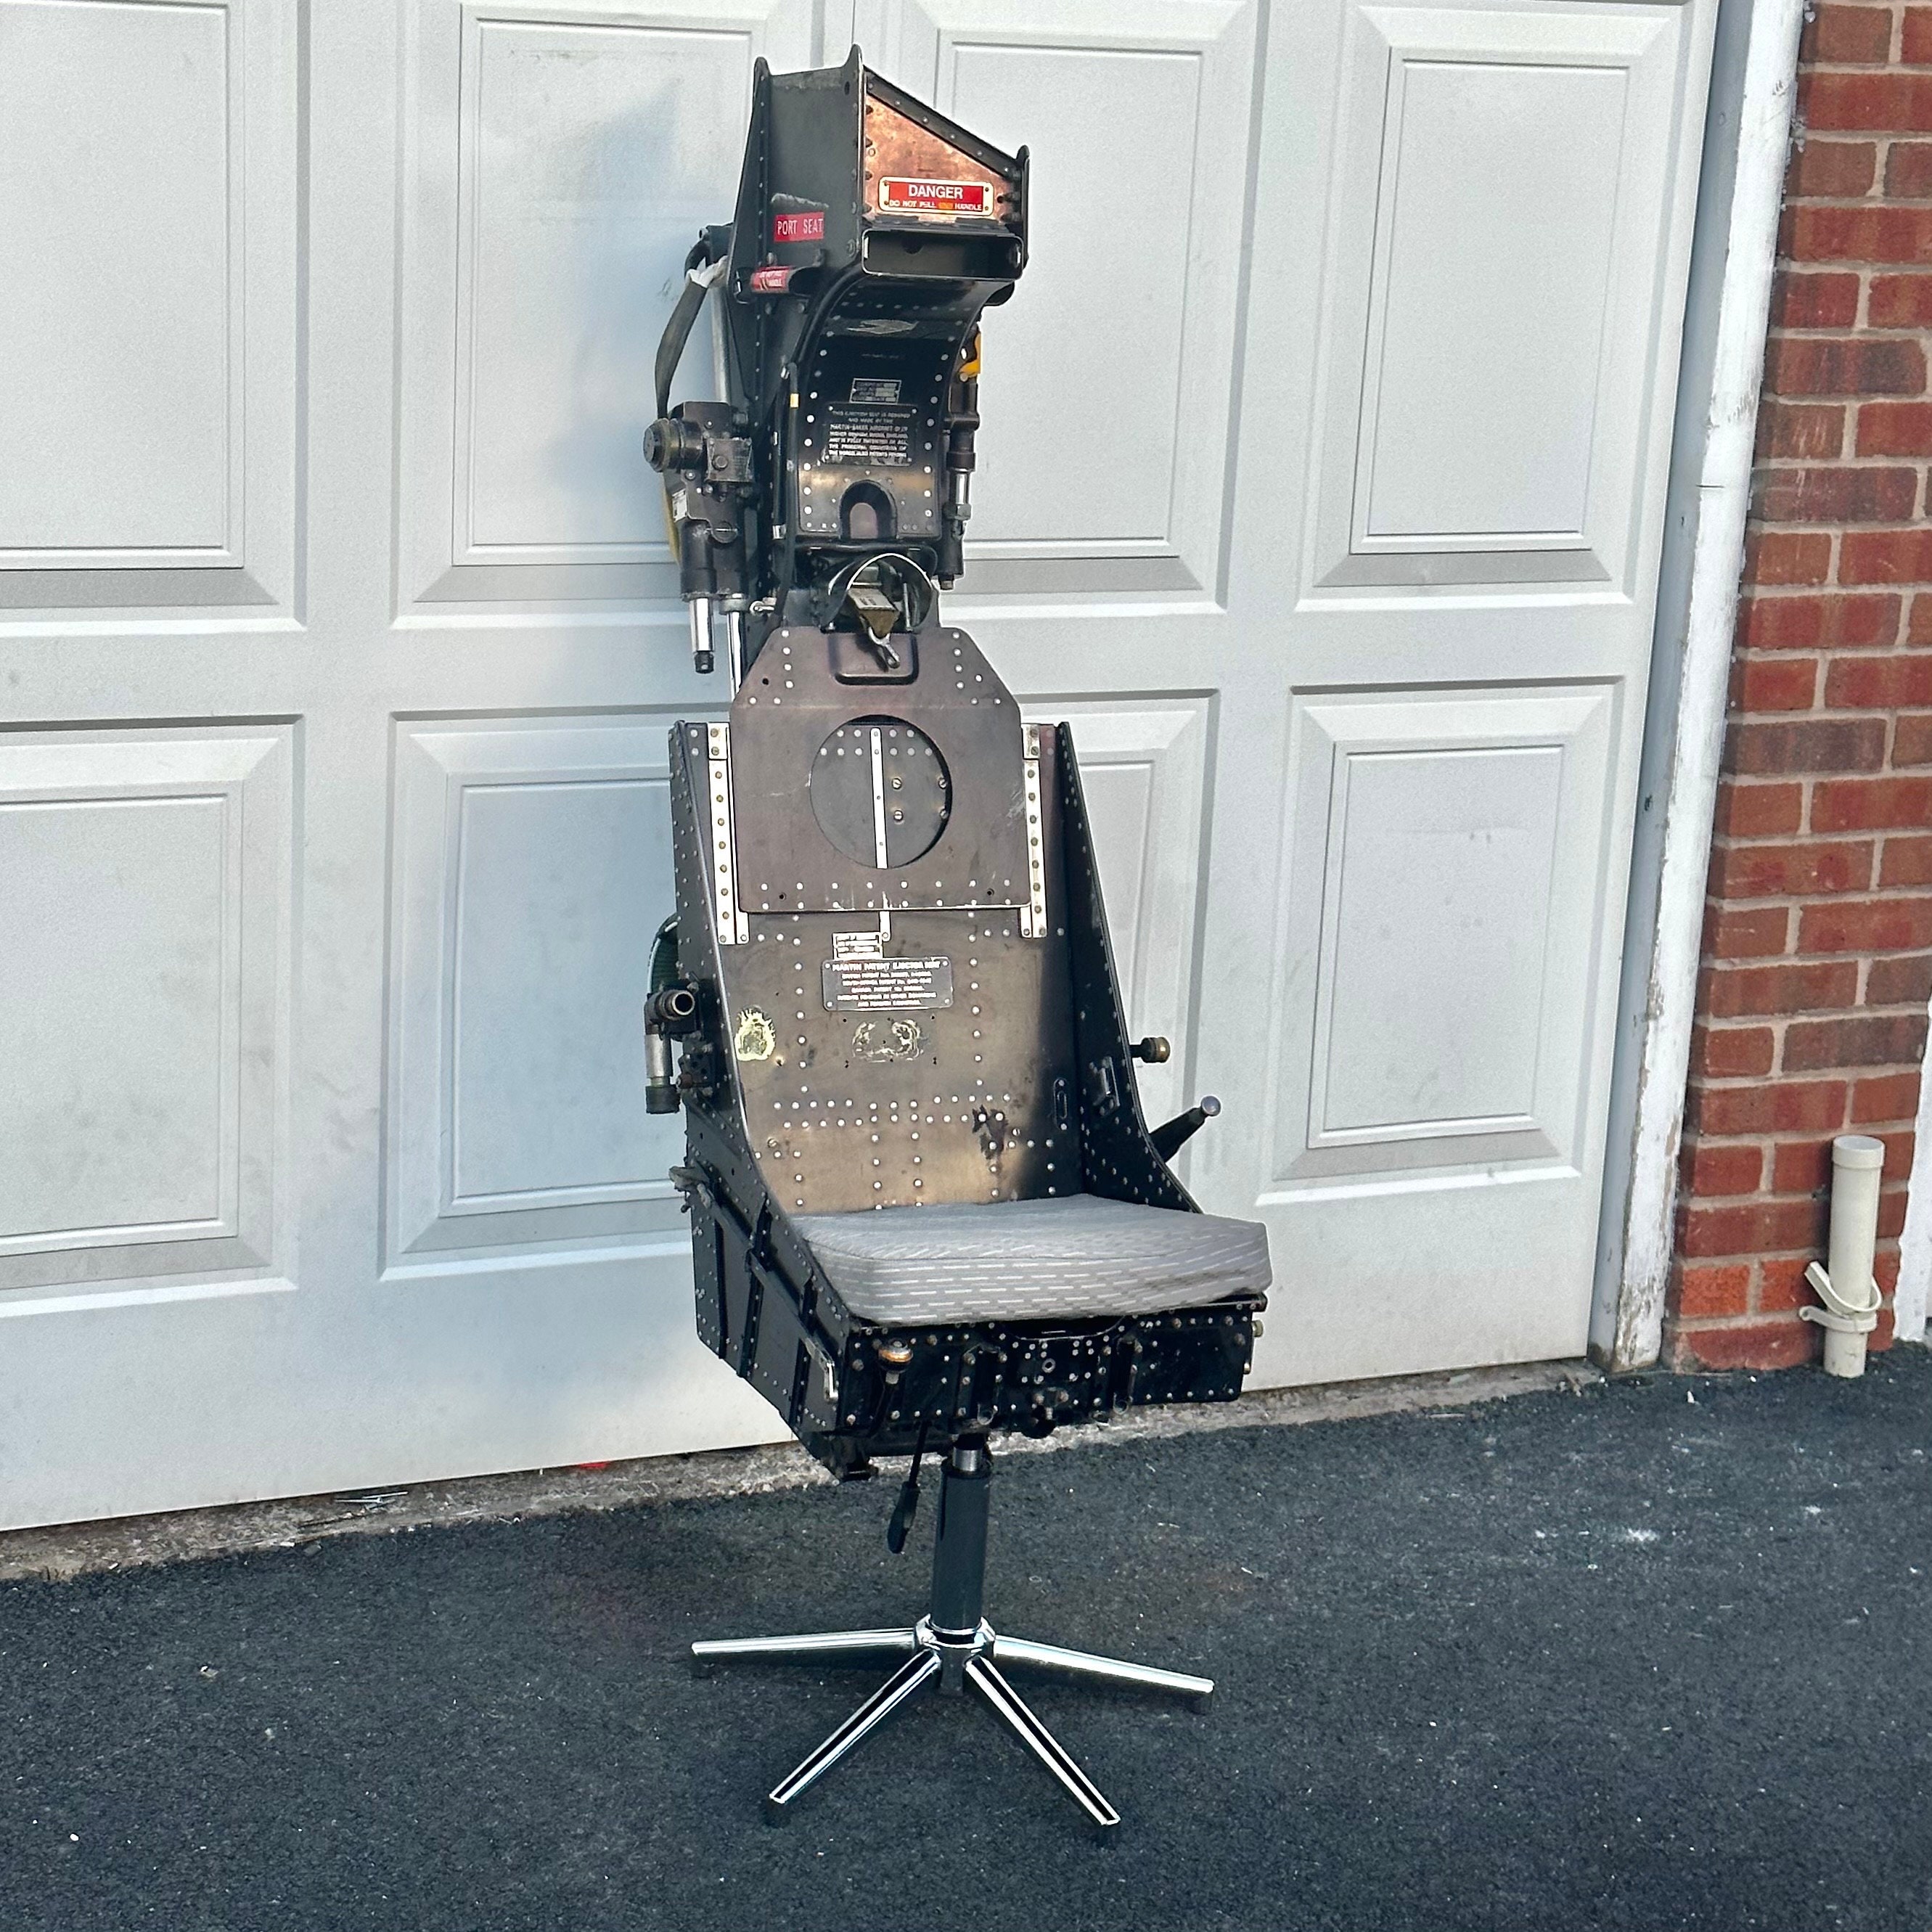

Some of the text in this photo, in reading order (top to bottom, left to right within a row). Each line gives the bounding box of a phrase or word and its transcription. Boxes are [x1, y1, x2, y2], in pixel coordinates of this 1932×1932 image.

[908, 184, 963, 199] DANGER
[777, 218, 824, 235] PORT SEAT
[832, 963, 862, 972] MARTIN
